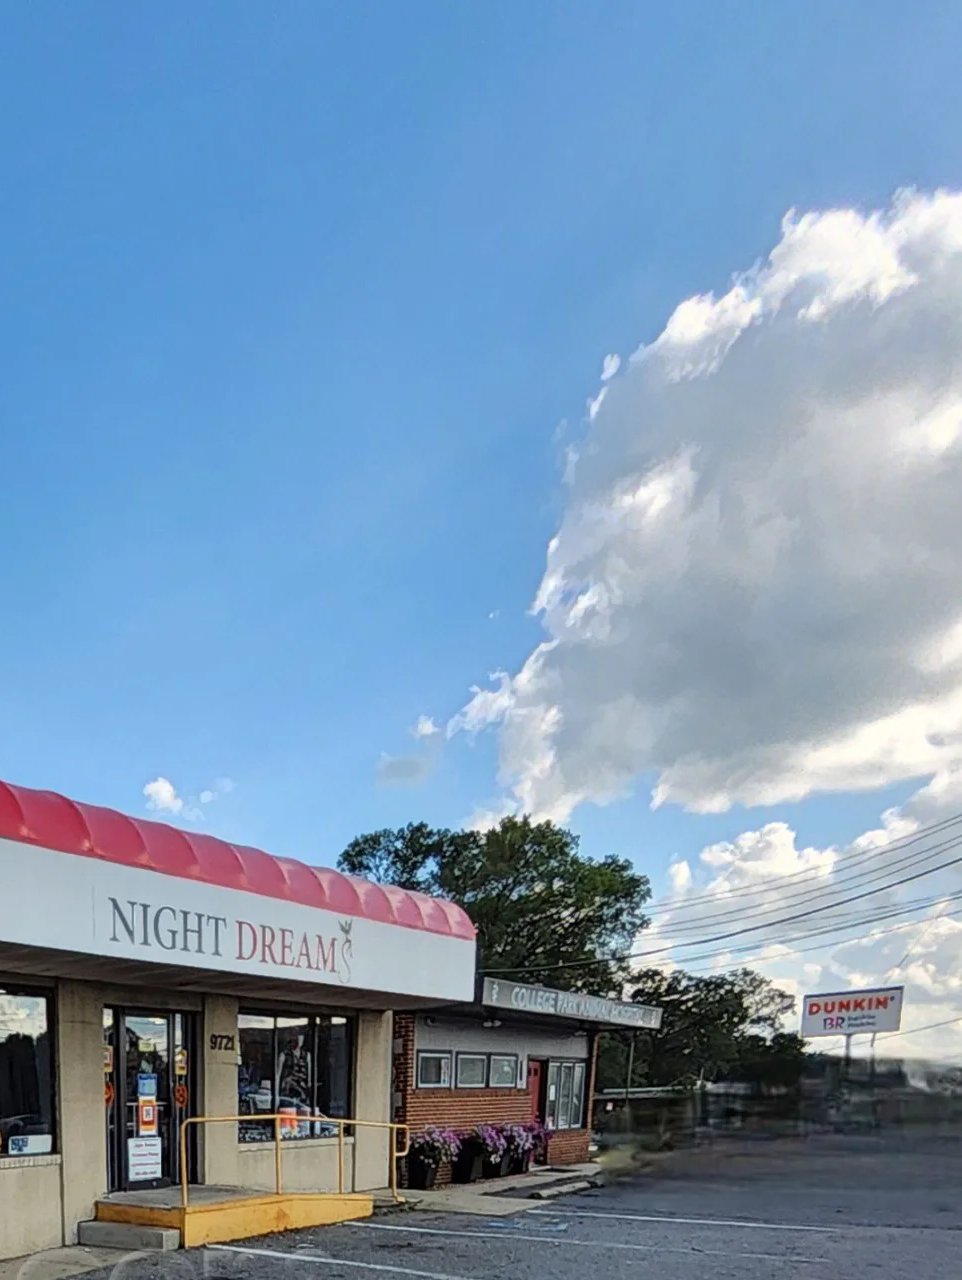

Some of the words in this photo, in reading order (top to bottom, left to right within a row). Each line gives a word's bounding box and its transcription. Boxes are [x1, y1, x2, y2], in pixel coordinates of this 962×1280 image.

[108, 897, 227, 957] NIGHT
[511, 986, 557, 1012] COLLEGE
[557, 994, 578, 1014] PARK
[210, 1033, 235, 1051] 9721
